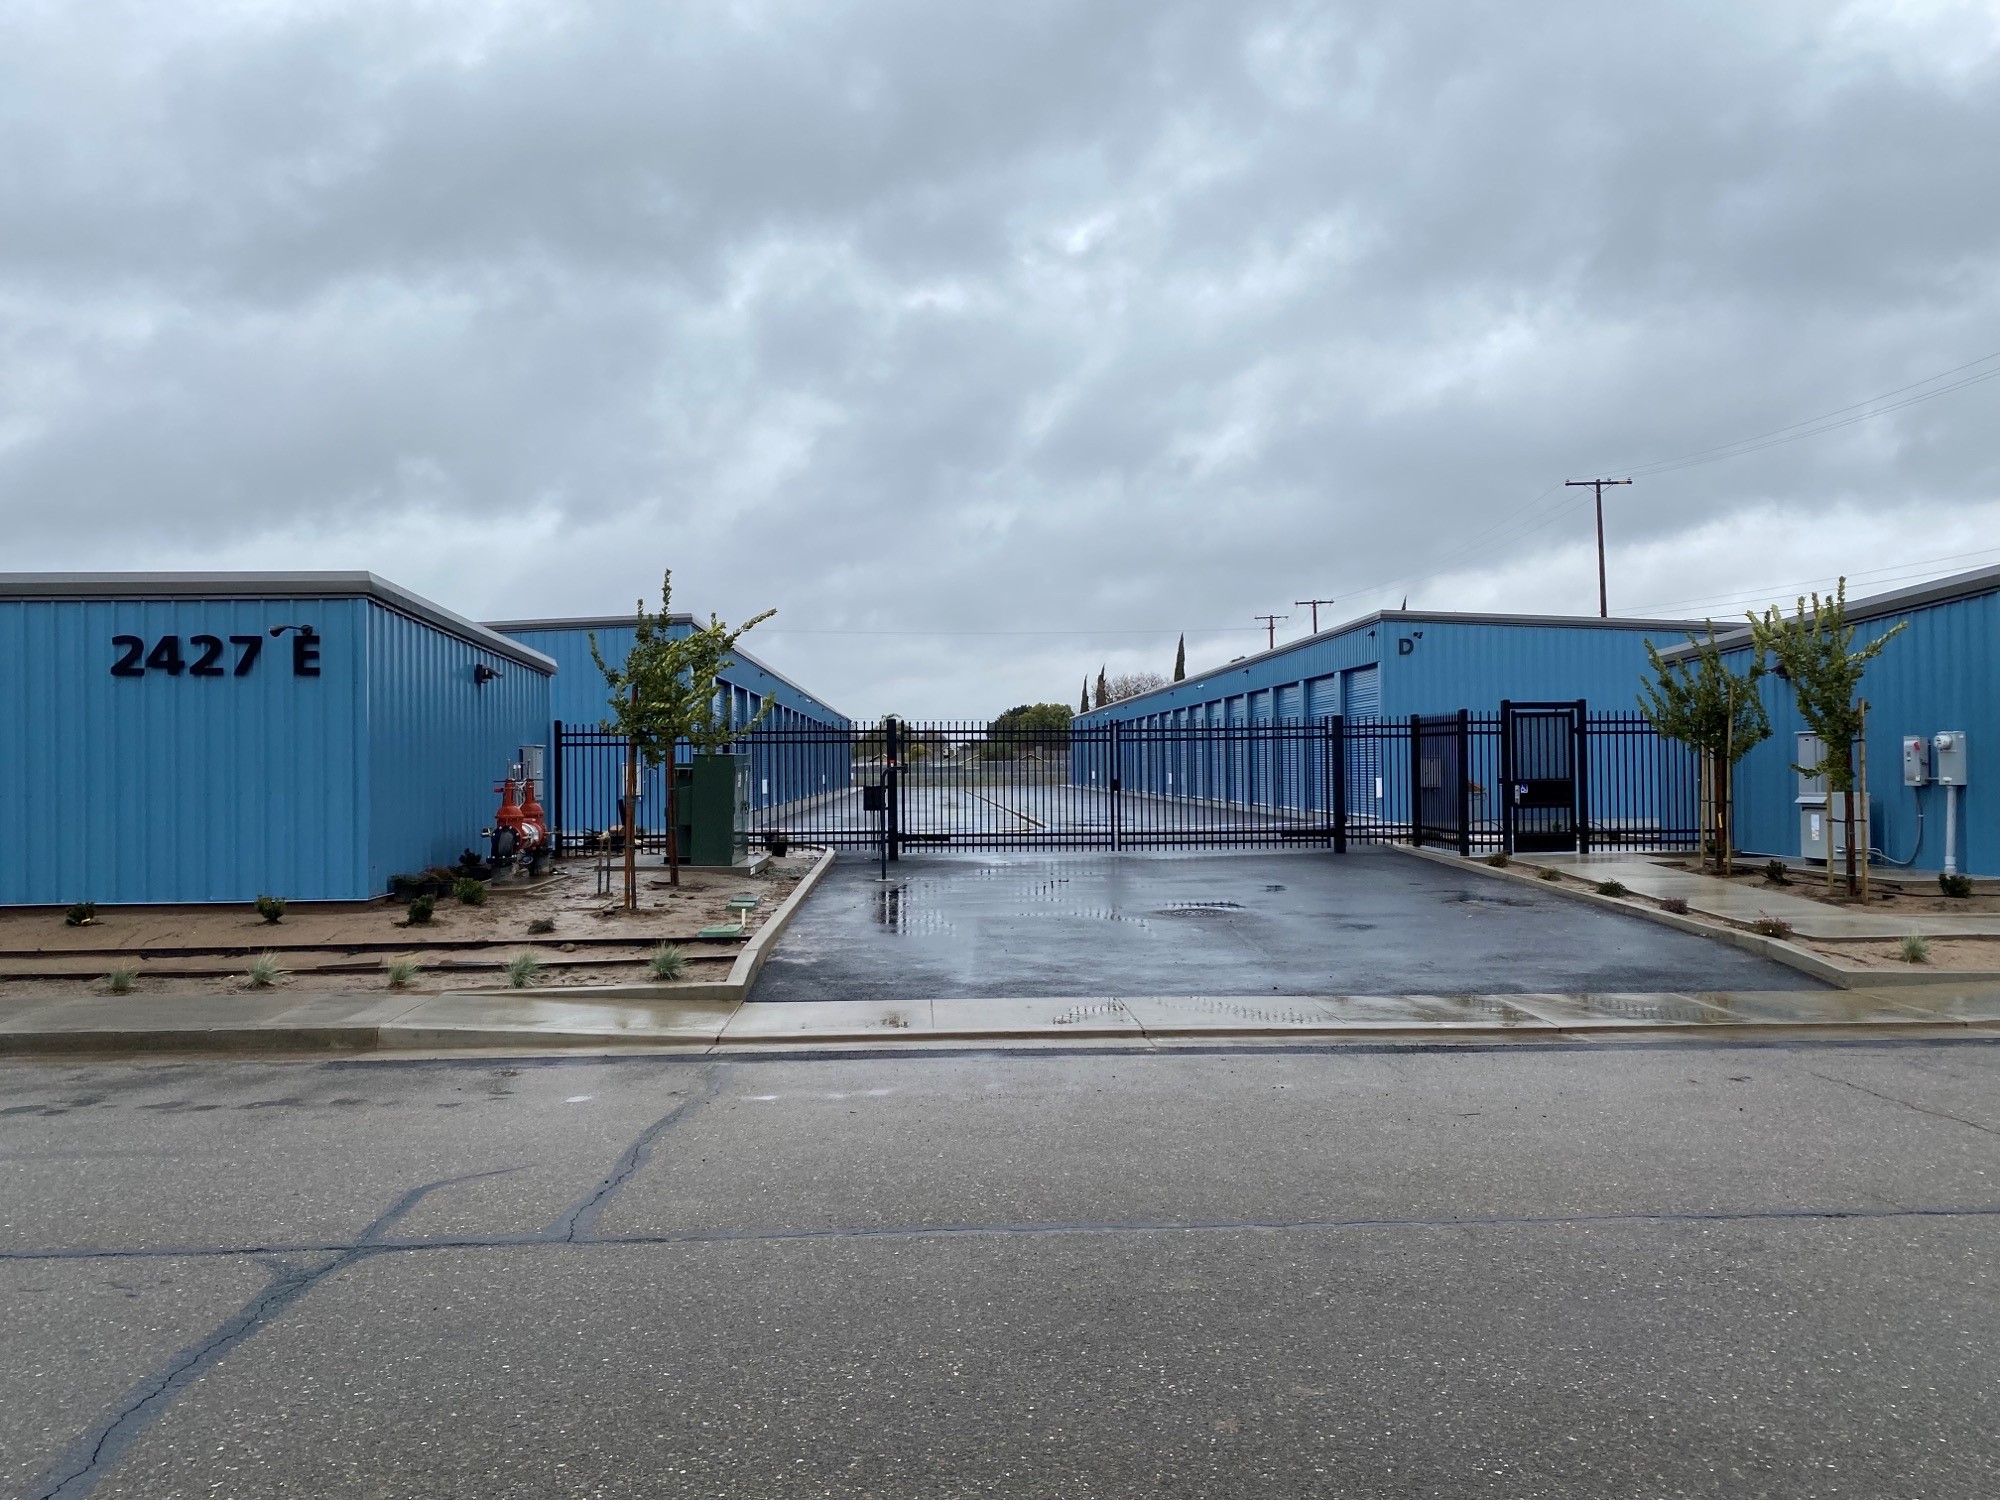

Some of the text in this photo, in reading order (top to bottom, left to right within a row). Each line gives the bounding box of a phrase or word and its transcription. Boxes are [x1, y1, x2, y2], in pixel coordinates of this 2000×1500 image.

[110, 634, 321, 676] 2427 E
[1399, 638, 1414, 655] D
